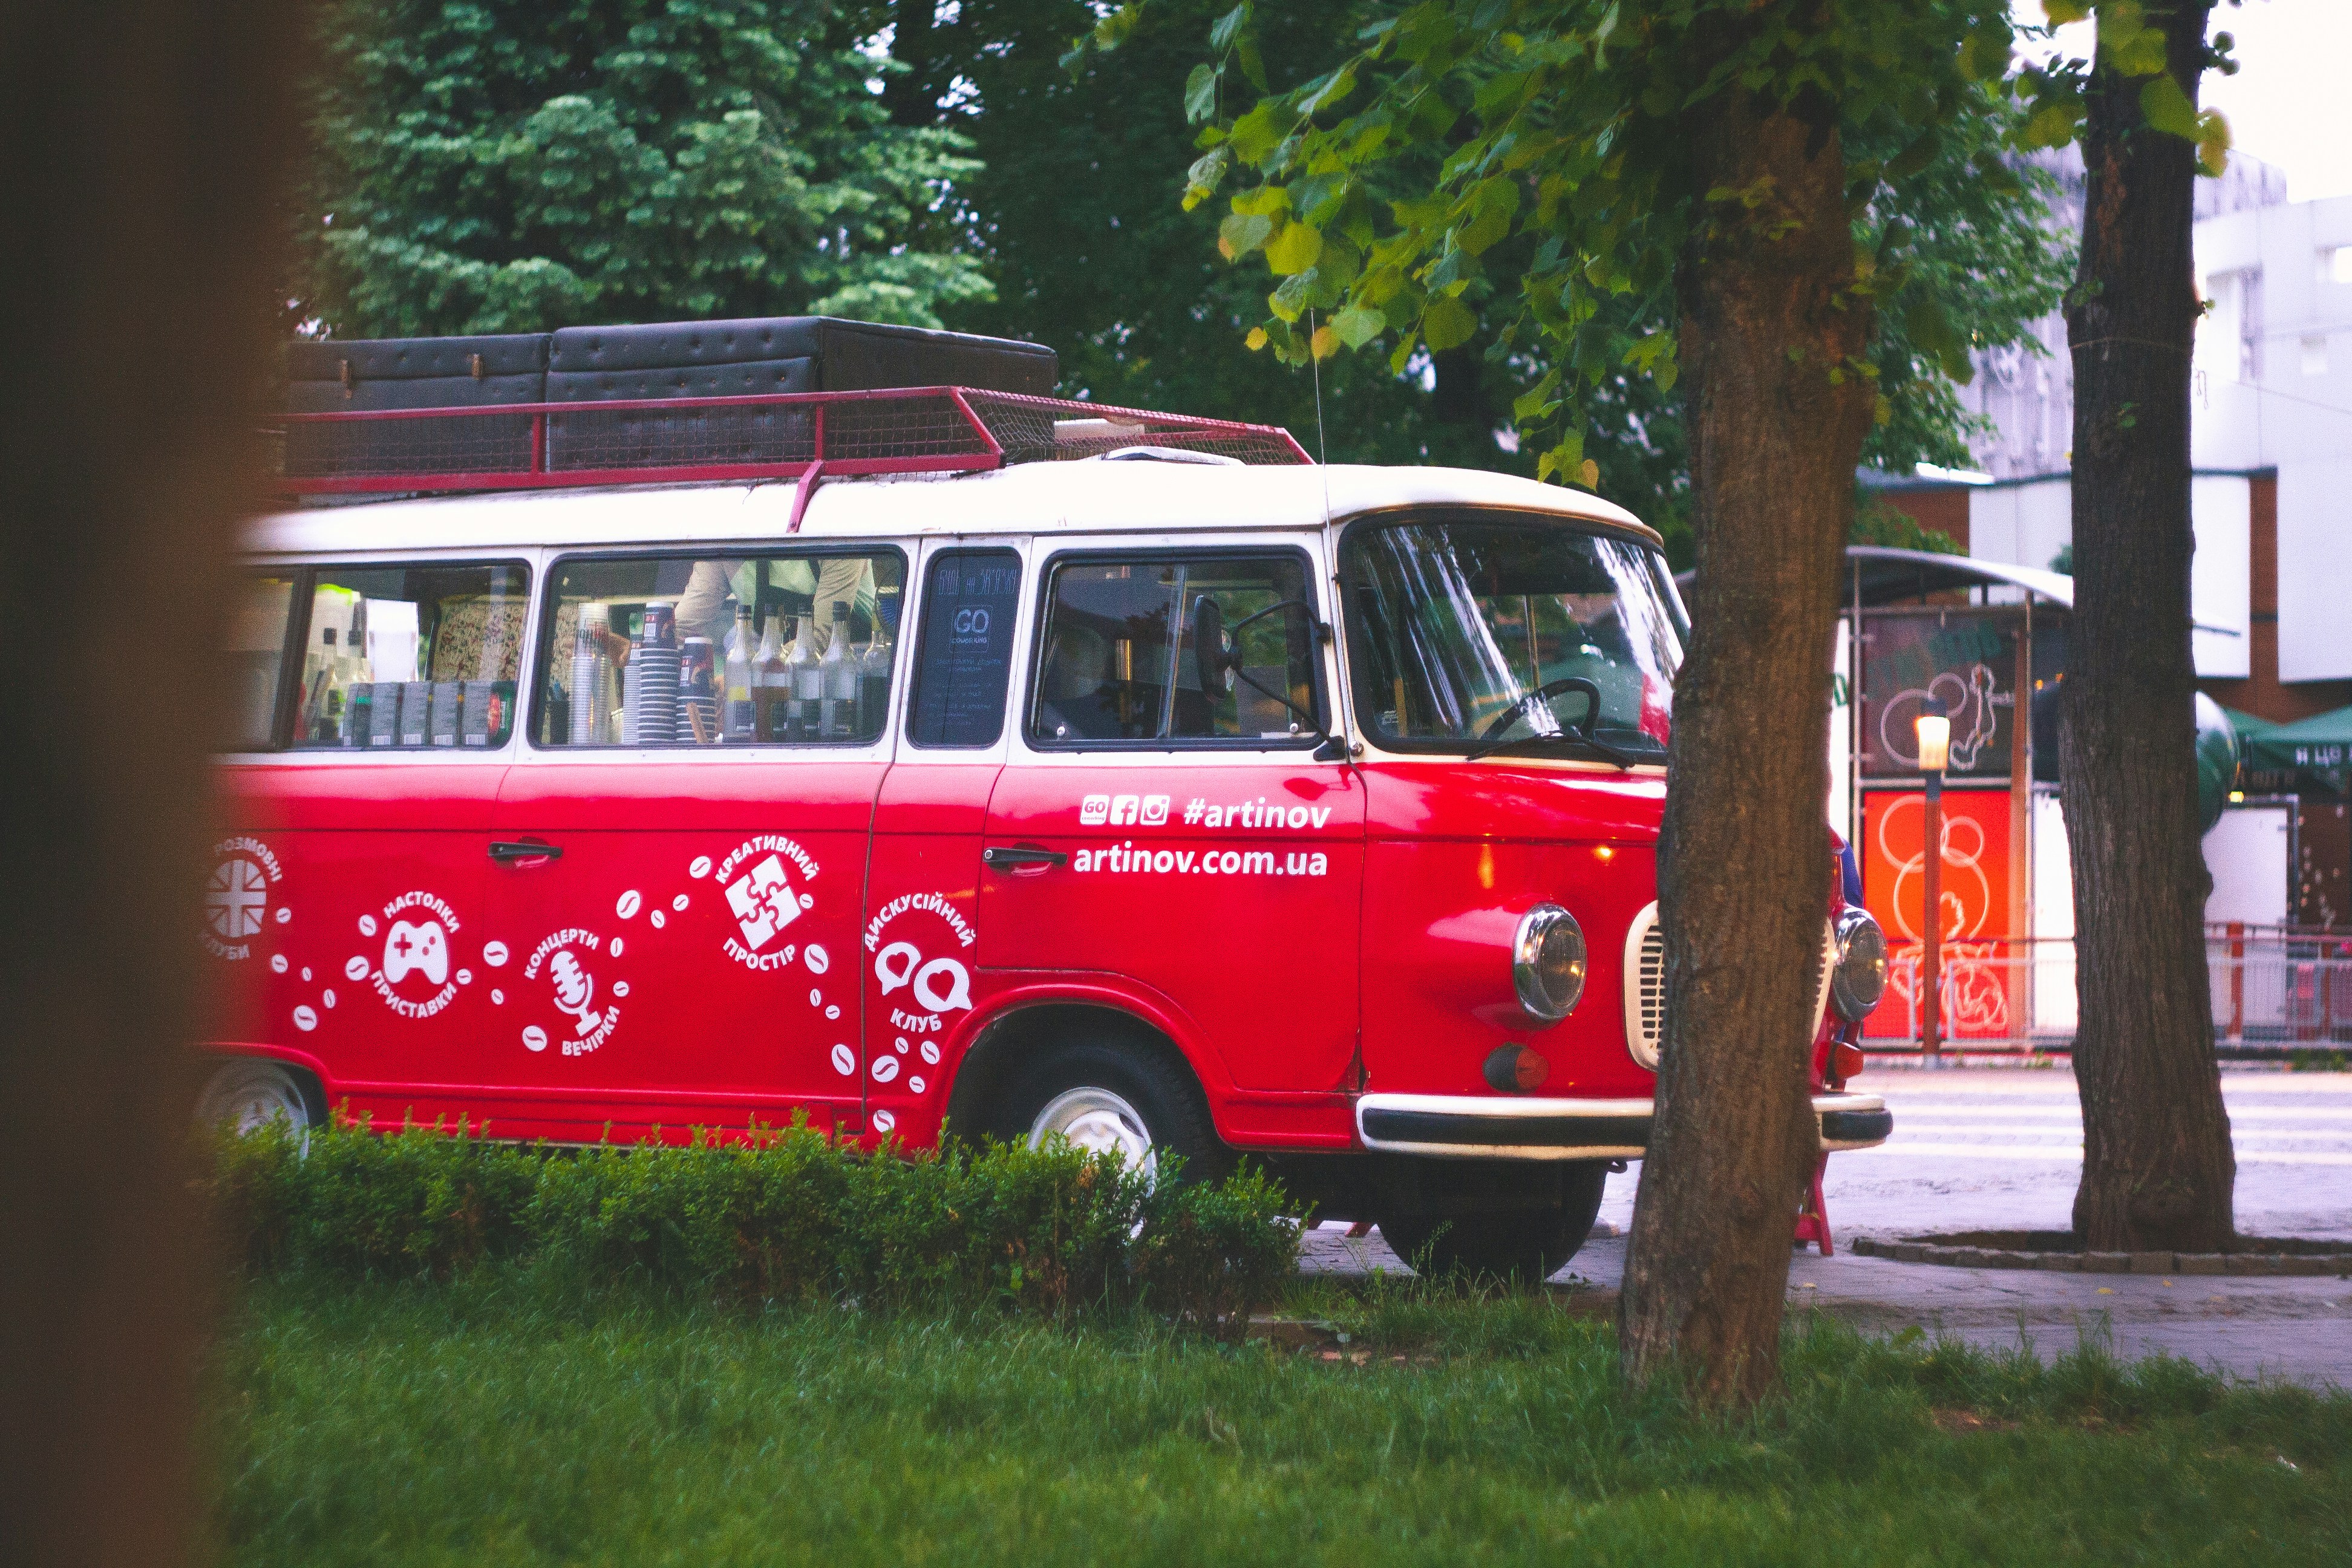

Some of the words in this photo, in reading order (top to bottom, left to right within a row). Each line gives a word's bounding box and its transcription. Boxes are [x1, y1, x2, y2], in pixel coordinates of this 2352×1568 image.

[954, 609, 990, 633] GO
[1084, 800, 1106, 813] GO
[1184, 797, 1331, 829] #artinov
[715, 835, 819, 884] КРЕАТИВНИЙ
[1074, 841, 1327, 875] artinov.com.ua
[384, 891, 460, 933] НАСТОЛКИ
[864, 891, 976, 952] ДИСКУСІЙНИЙ
[524, 928, 599, 979] КОНЦЕРТИ
[722, 937, 795, 971] ПРОСТІР
[370, 970, 457, 1019] ПРИСТАВКИ
[562, 1006, 620, 1056] ВЕЧІРКИ
[890, 1007, 942, 1033] КЛУБ
